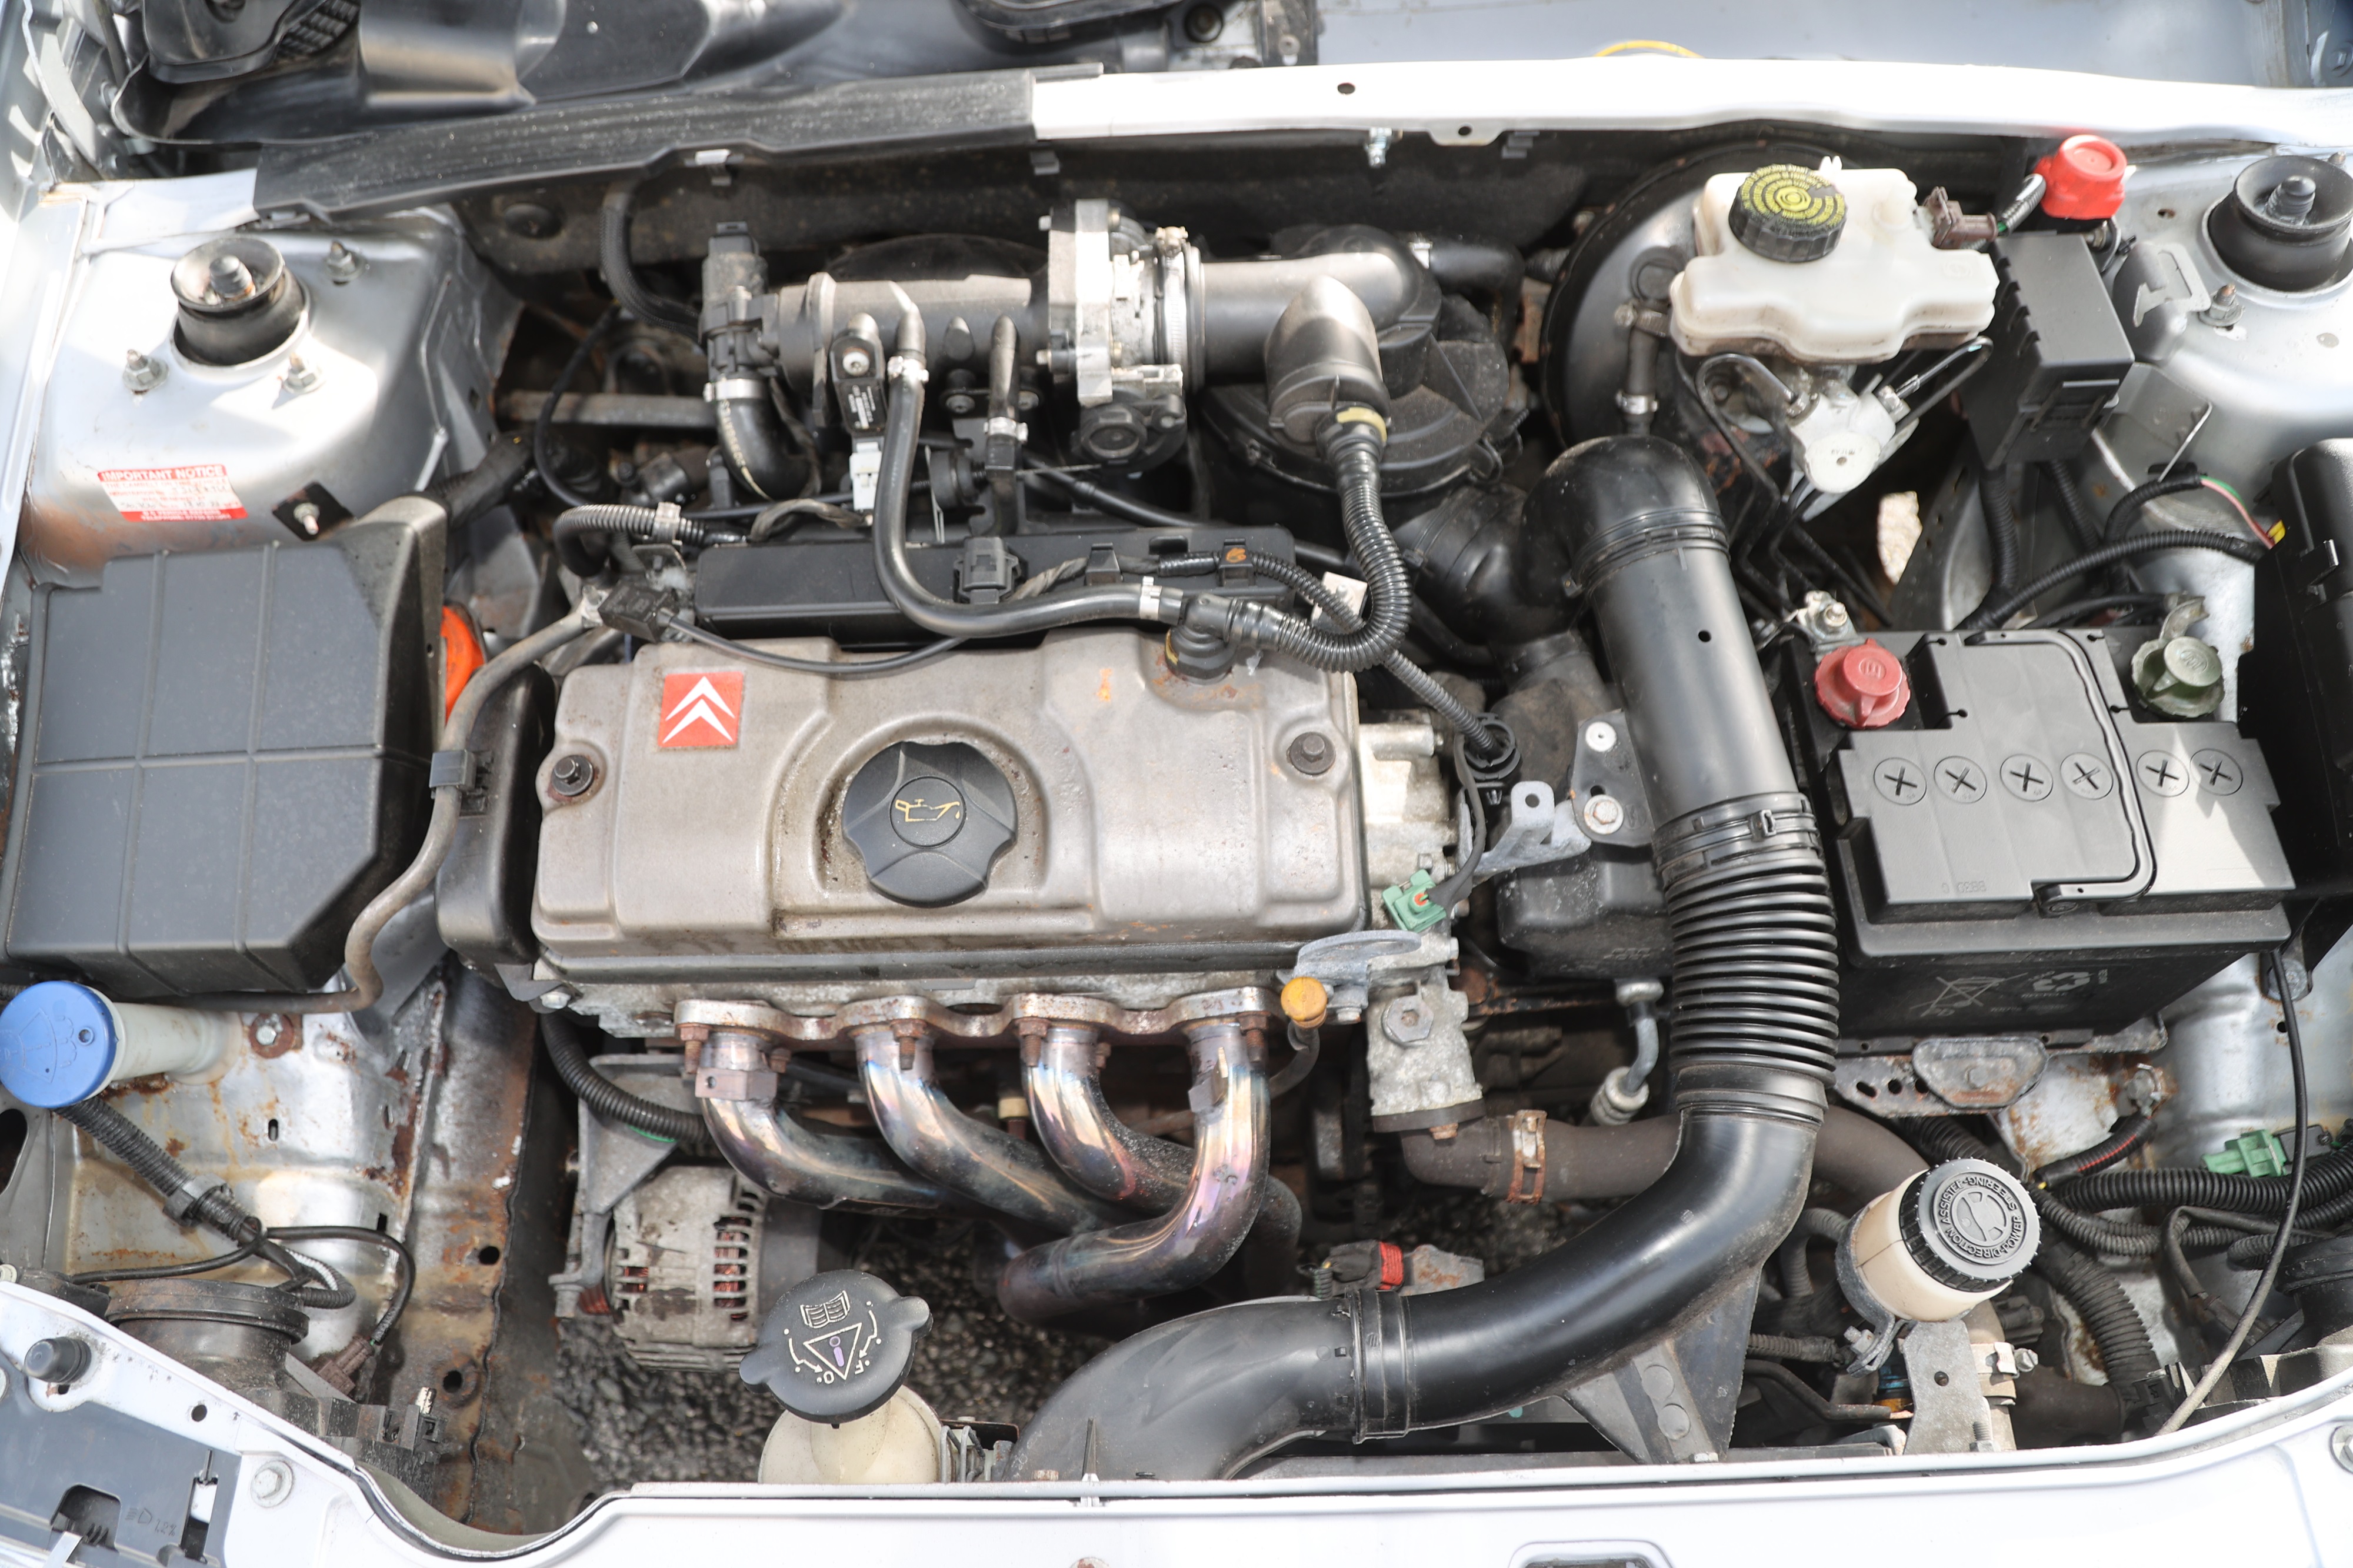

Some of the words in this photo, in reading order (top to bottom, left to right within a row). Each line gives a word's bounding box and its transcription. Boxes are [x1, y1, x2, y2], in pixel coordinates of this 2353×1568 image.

[102, 471, 173, 481] IMPORTANT
[176, 465, 224, 479] NOTICE
[1967, 1175, 2018, 1212] STEERING
[1947, 1227, 2002, 1259] DIRECTION
[2001, 1215, 2024, 1255] POWER
